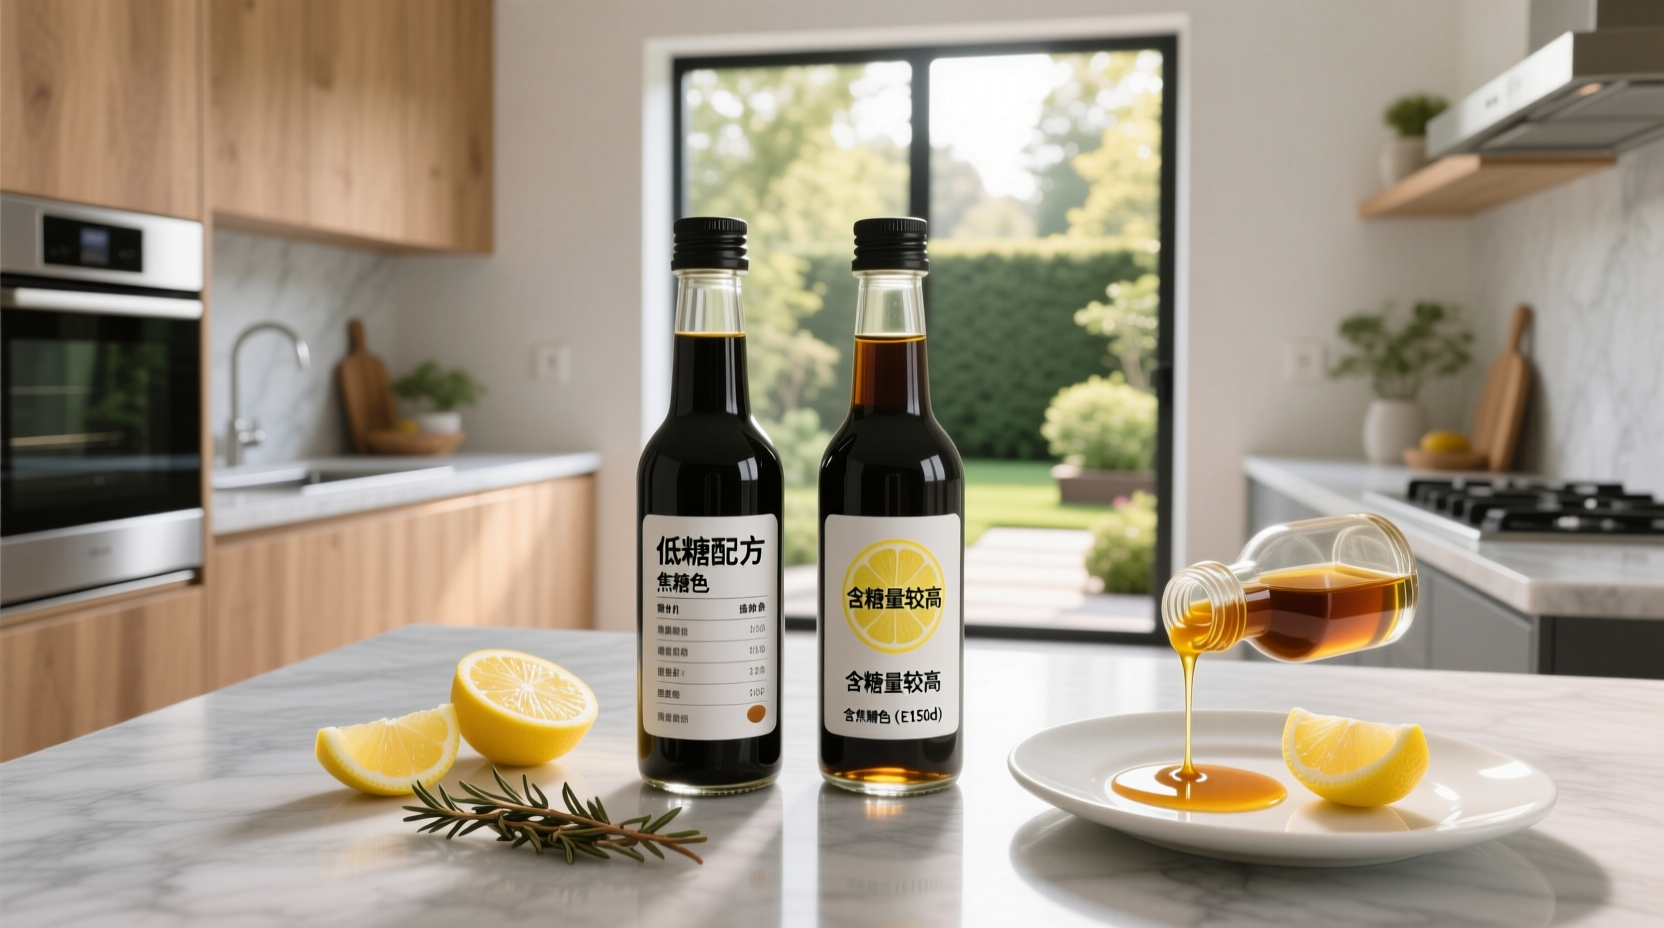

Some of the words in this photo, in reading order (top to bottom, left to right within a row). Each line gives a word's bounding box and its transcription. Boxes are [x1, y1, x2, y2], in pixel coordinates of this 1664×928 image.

[656, 534, 766, 567] 低糖配方
[656, 571, 710, 594] 焦糖色
[847, 586, 942, 610] 含糖量较高
[845, 670, 941, 694] 含糖量较高
[895, 706, 943, 725] (E150d)
